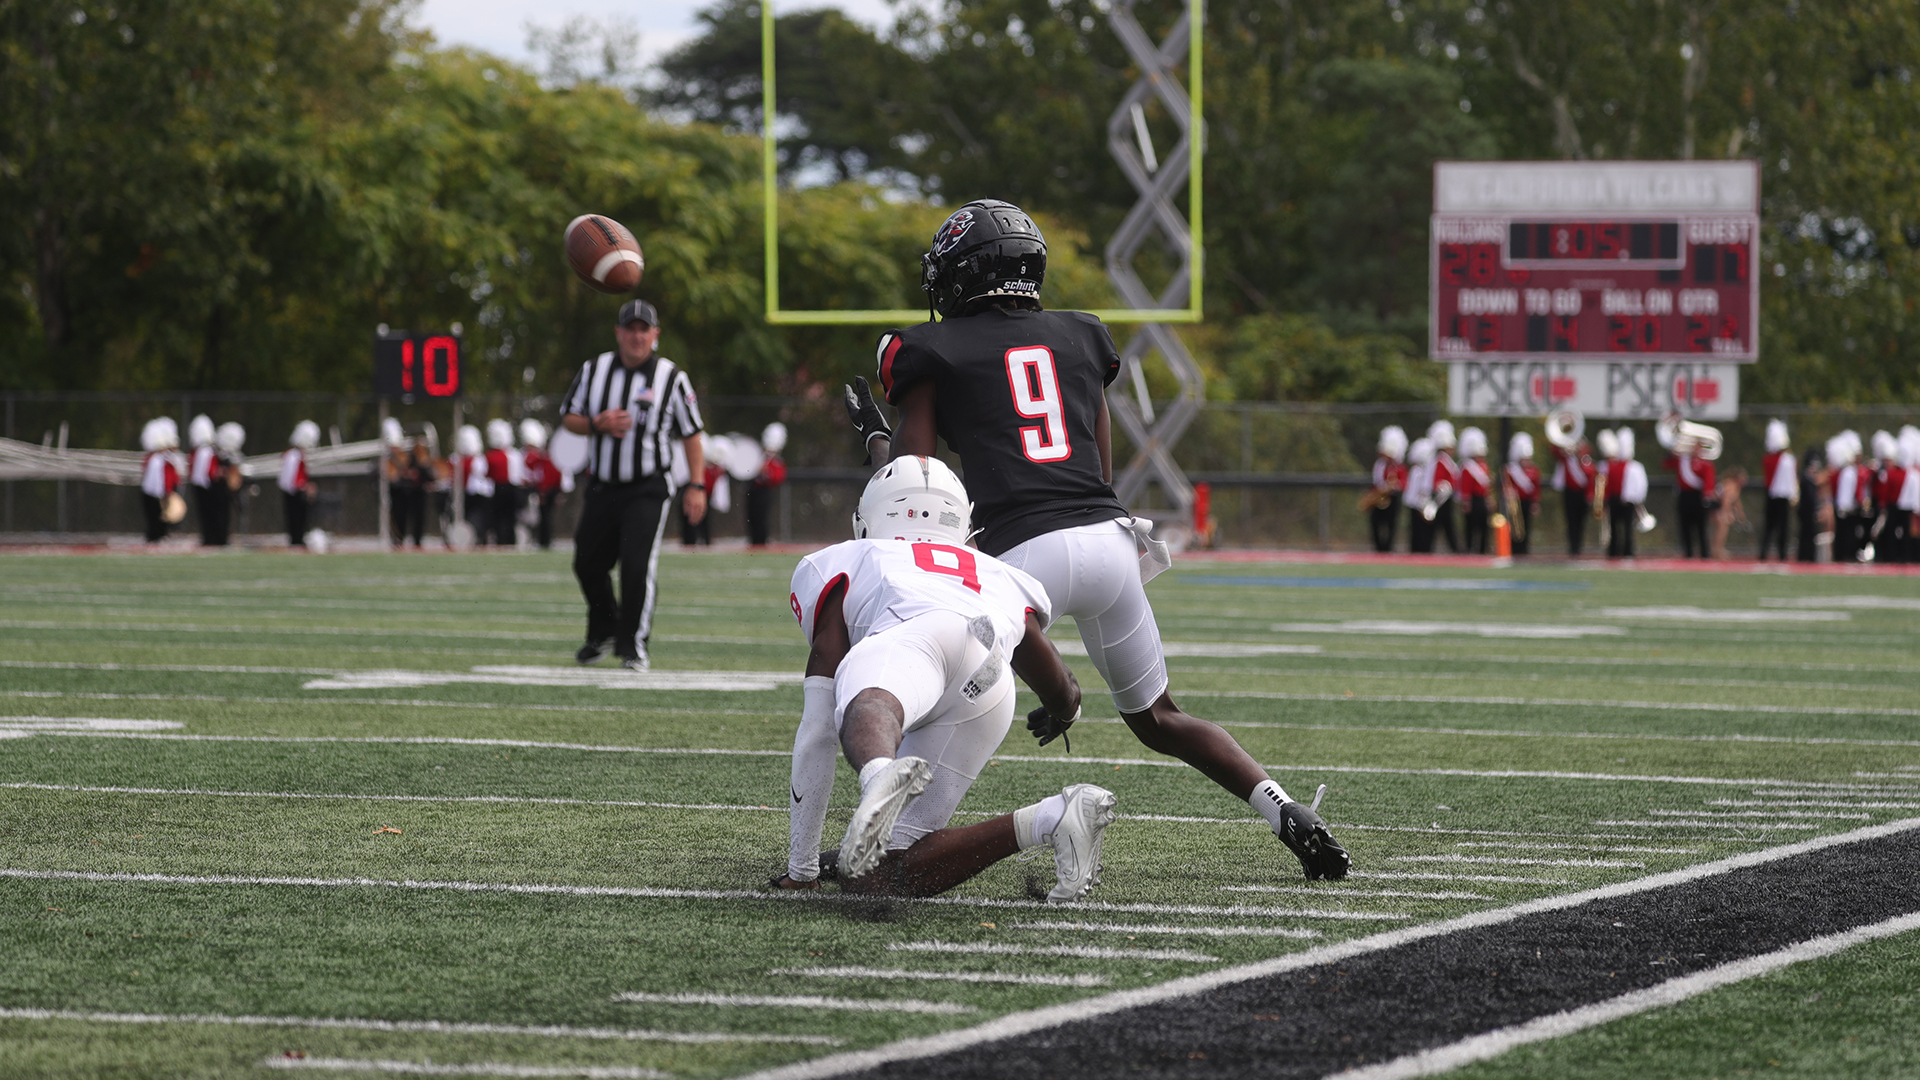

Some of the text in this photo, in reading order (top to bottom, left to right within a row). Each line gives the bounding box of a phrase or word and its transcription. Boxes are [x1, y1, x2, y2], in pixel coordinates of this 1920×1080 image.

[1687, 219, 1750, 245] GUEST
[1020, 266, 1027, 275] 9
[1440, 243, 1496, 285] 28
[1003, 279, 1036, 291] schutt
[1457, 287, 1519, 316] DOWN
[1524, 287, 1551, 316] TO
[1601, 288, 1673, 316] BALL ON
[401, 336, 460, 397] 10
[1004, 344, 1072, 463] 9
